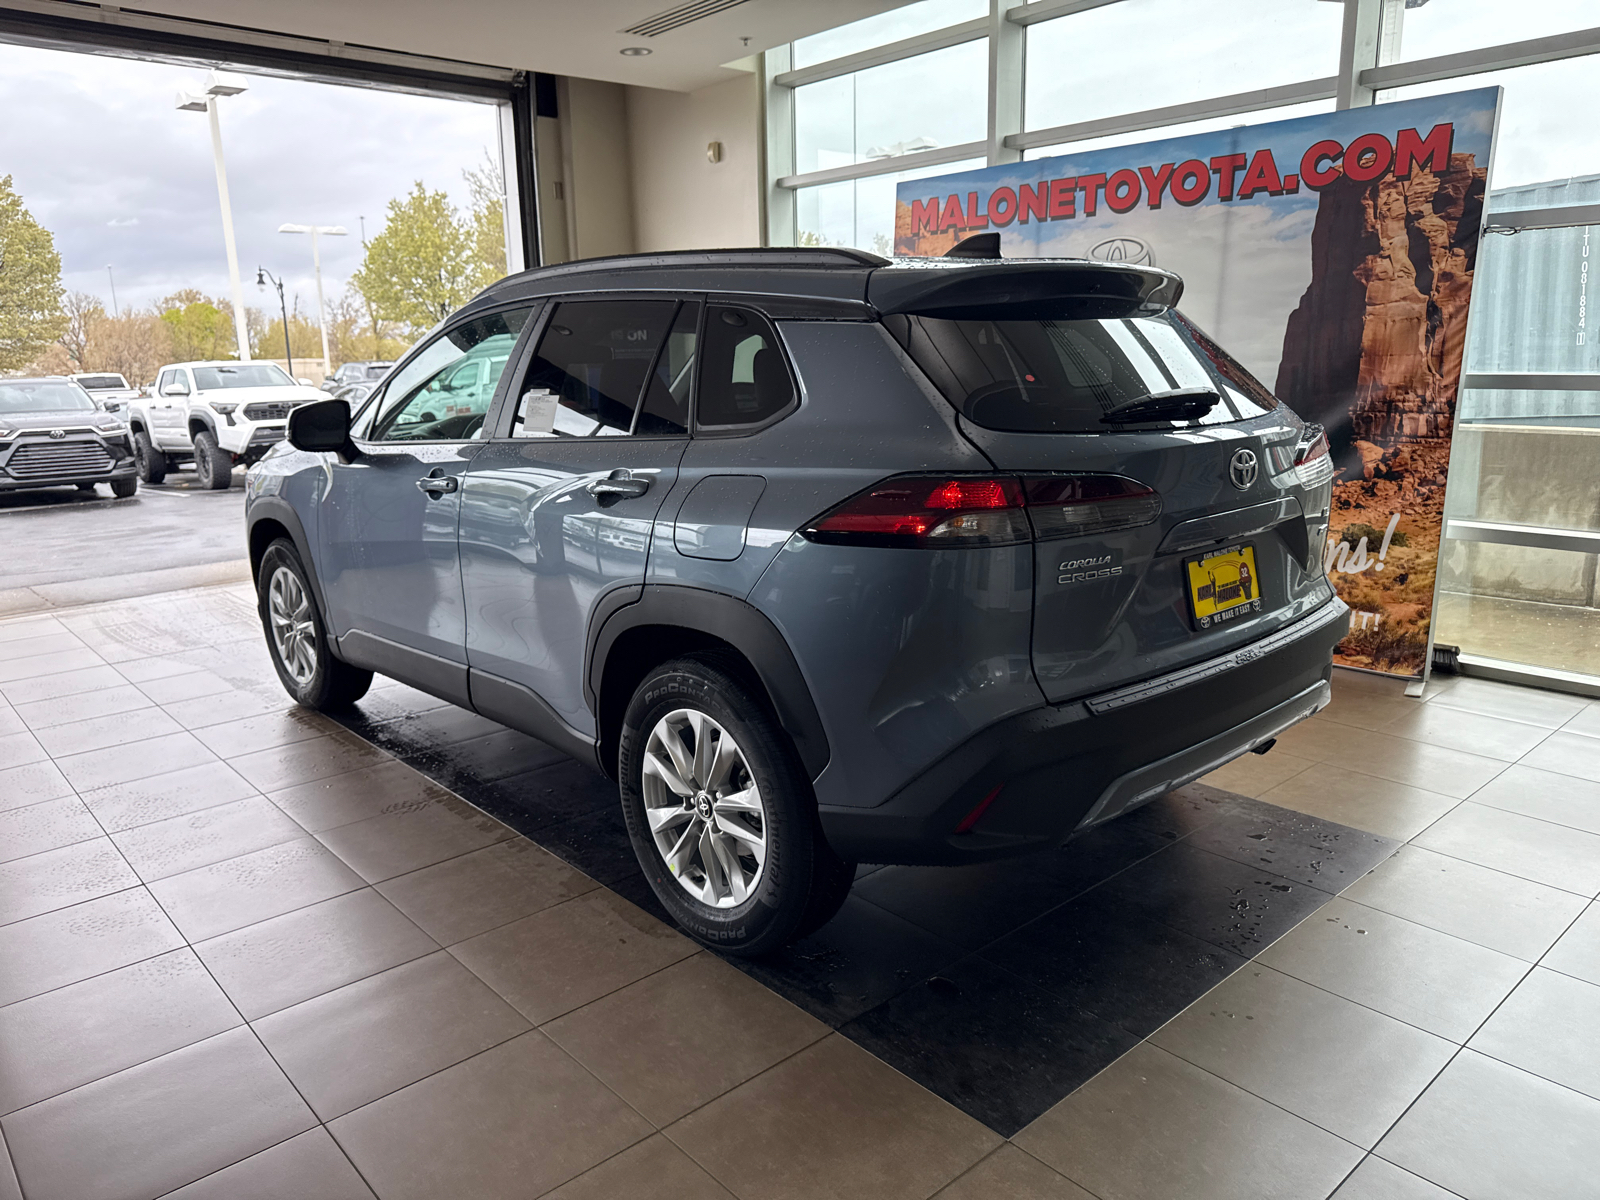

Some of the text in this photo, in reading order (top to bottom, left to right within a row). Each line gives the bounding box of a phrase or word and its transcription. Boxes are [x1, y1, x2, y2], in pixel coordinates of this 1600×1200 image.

[910, 123, 1455, 236] MALONETOYOTA.COM
[1578, 261, 1588, 329] 081884
[1058, 555, 1111, 570] COROLLA
[1240, 567, 1249, 578] 32
[1058, 566, 1123, 584] CROSS
[1213, 615, 1222, 624] WE
[1222, 609, 1235, 620] MAKE
[1239, 604, 1251, 614] EASY
[1350, 610, 1380, 632] IT!
